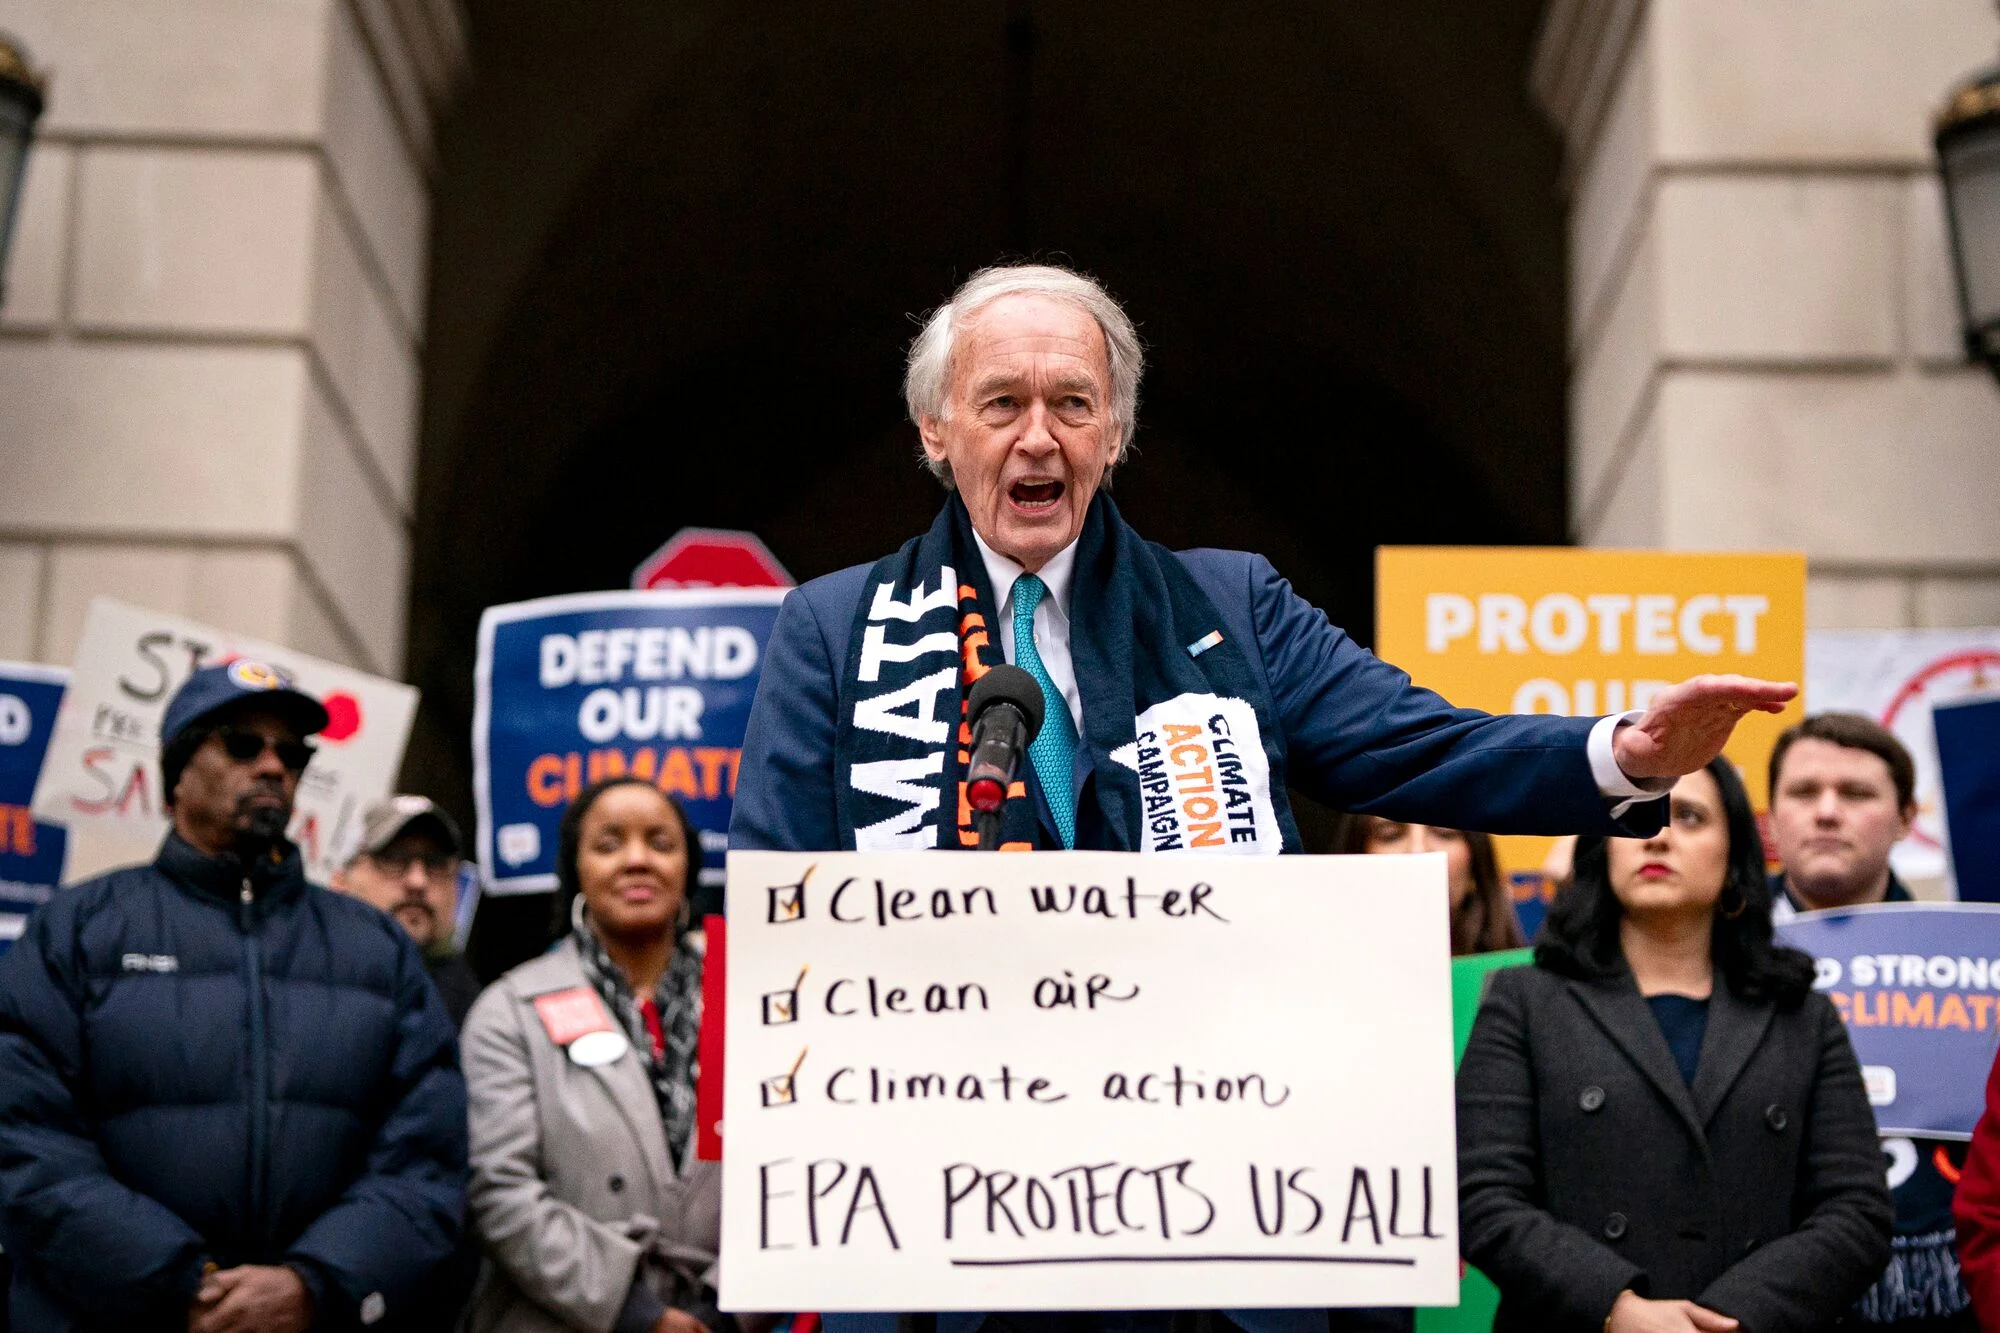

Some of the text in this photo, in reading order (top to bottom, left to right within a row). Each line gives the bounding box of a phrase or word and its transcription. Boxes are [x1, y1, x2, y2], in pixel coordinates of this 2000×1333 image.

[1426, 593, 1768, 654] PROTECT
[539, 626, 759, 689] DEFEND
[578, 686, 706, 743] OUR
[1137, 731, 1183, 852] CAMPAIGN
[1162, 724, 1226, 848] ACTION
[1208, 714, 1257, 843] CLIMATE
[829, 877, 998, 928] Clean
[824, 976, 989, 1019] Clean
[1829, 990, 2000, 1033] CLIMAT
[825, 1065, 1290, 1107] Climate action
[759, 1158, 1446, 1251] EPA PROTECTS US ALL
